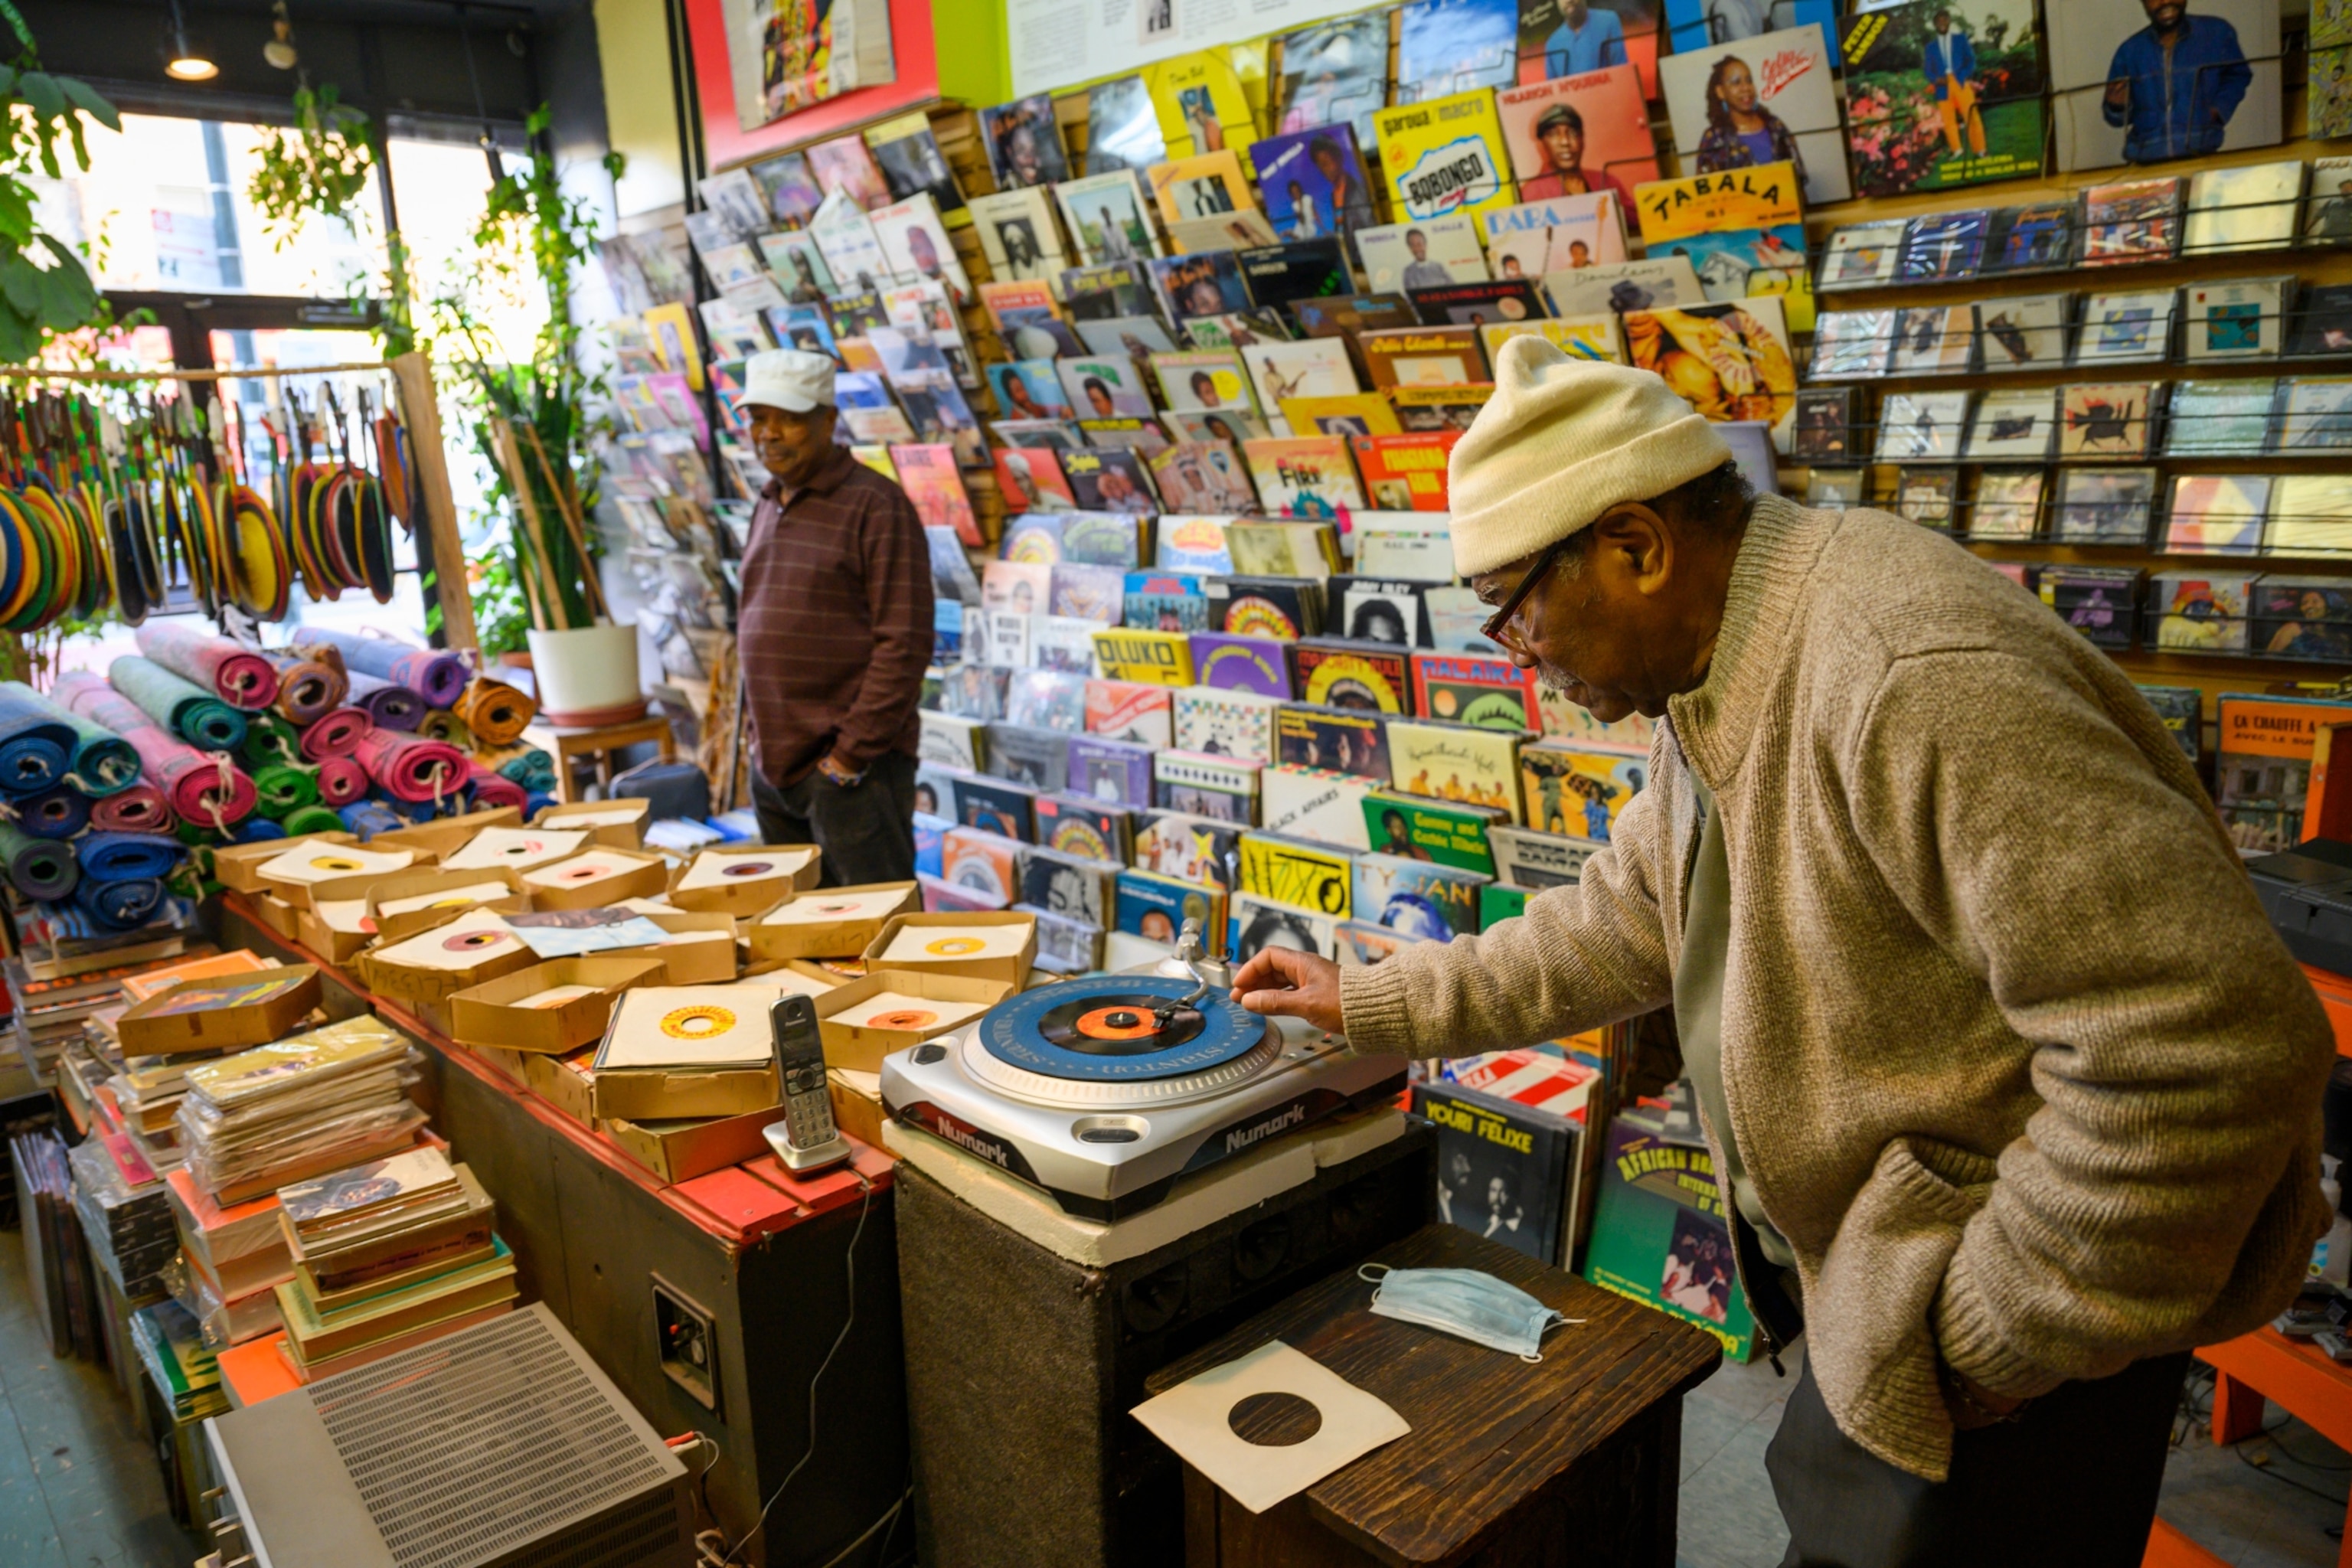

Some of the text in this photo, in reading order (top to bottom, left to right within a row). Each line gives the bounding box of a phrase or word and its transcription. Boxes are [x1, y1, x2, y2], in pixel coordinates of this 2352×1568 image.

[1383, 96, 1484, 137] garoua macro
[1409, 152, 1484, 206] BOBONGO
[1654, 174, 1779, 221] TABALA
[1357, 861, 1472, 907] TY-JAN
[1227, 1104, 1305, 1155] Numark
[1426, 1099, 1474, 1134] YOURI
[938, 1116, 1008, 1168] Numark
[1616, 1148, 1687, 1183] AFRICAN
